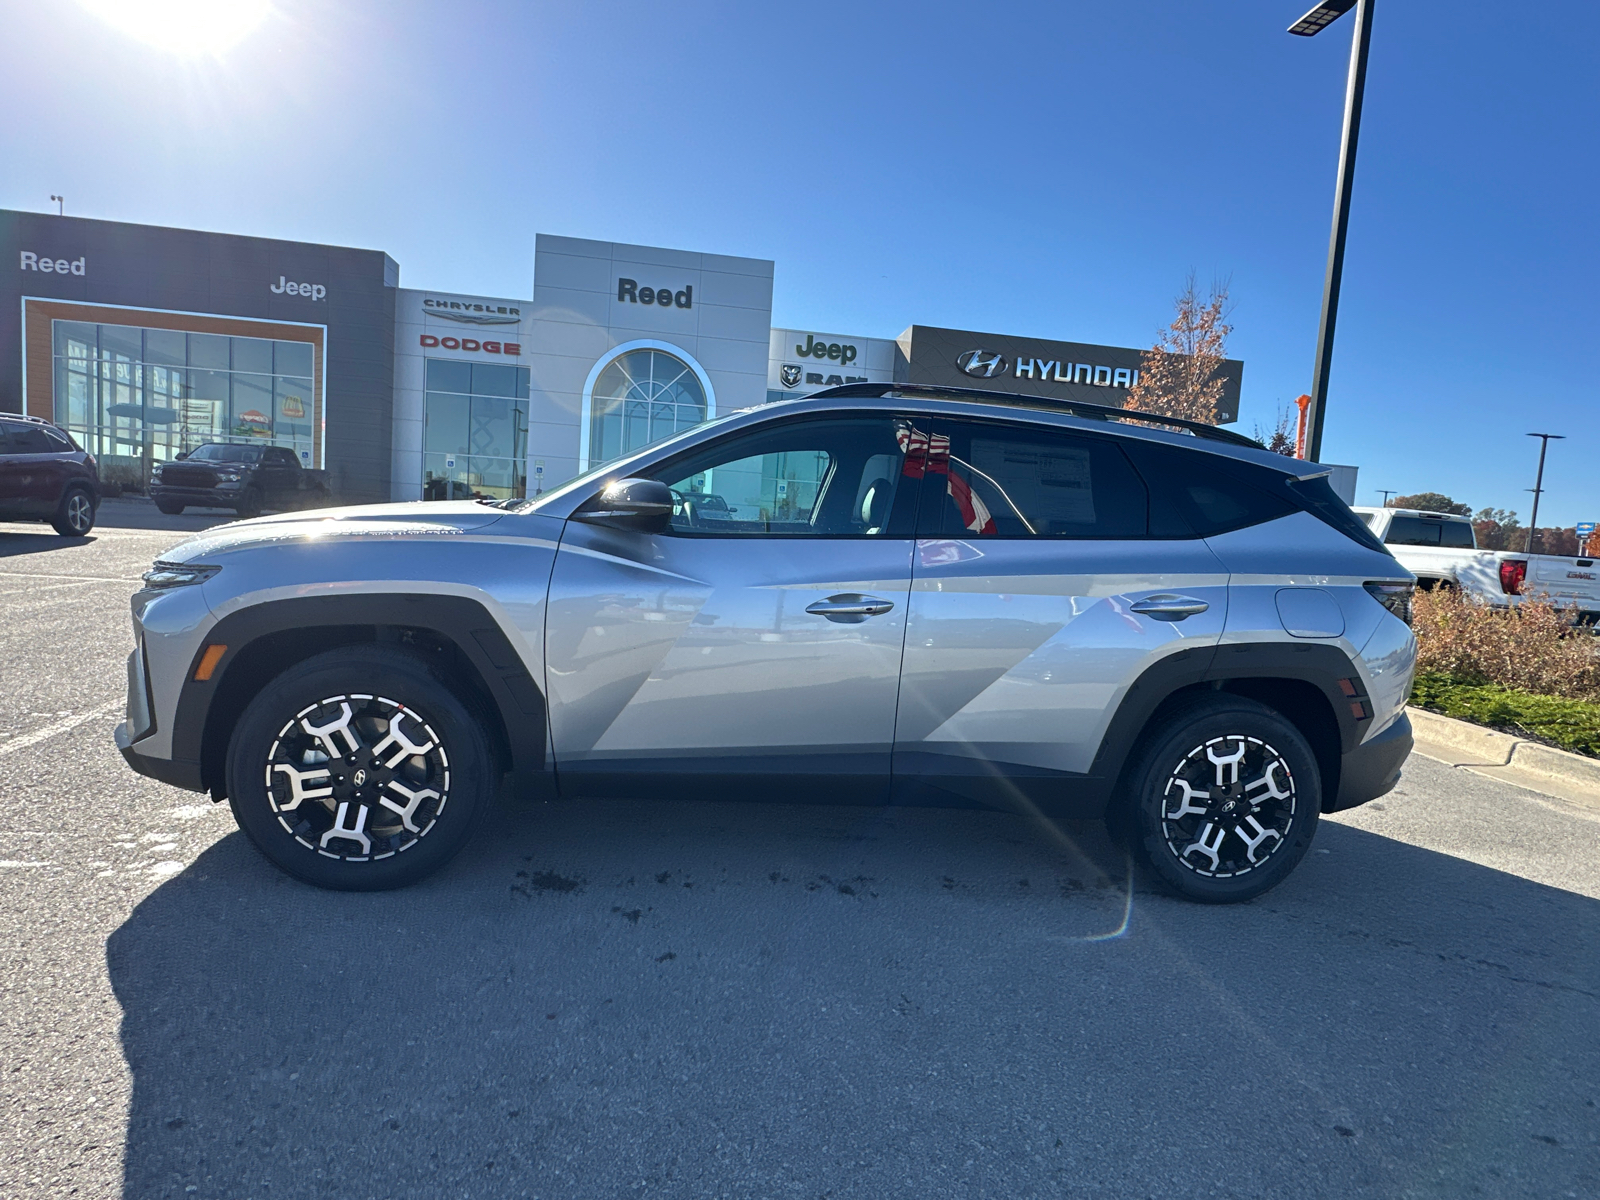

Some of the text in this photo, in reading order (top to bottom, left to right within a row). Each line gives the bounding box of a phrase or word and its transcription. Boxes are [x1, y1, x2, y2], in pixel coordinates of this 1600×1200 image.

[20, 250, 86, 276] Reed
[270, 275, 326, 302] Jeep
[617, 277, 693, 310] Reed
[423, 299, 520, 316] CHRYSLER
[420, 334, 521, 356] DODGE
[795, 334, 858, 366] Jeep
[1015, 356, 1140, 389] HYUNDAI
